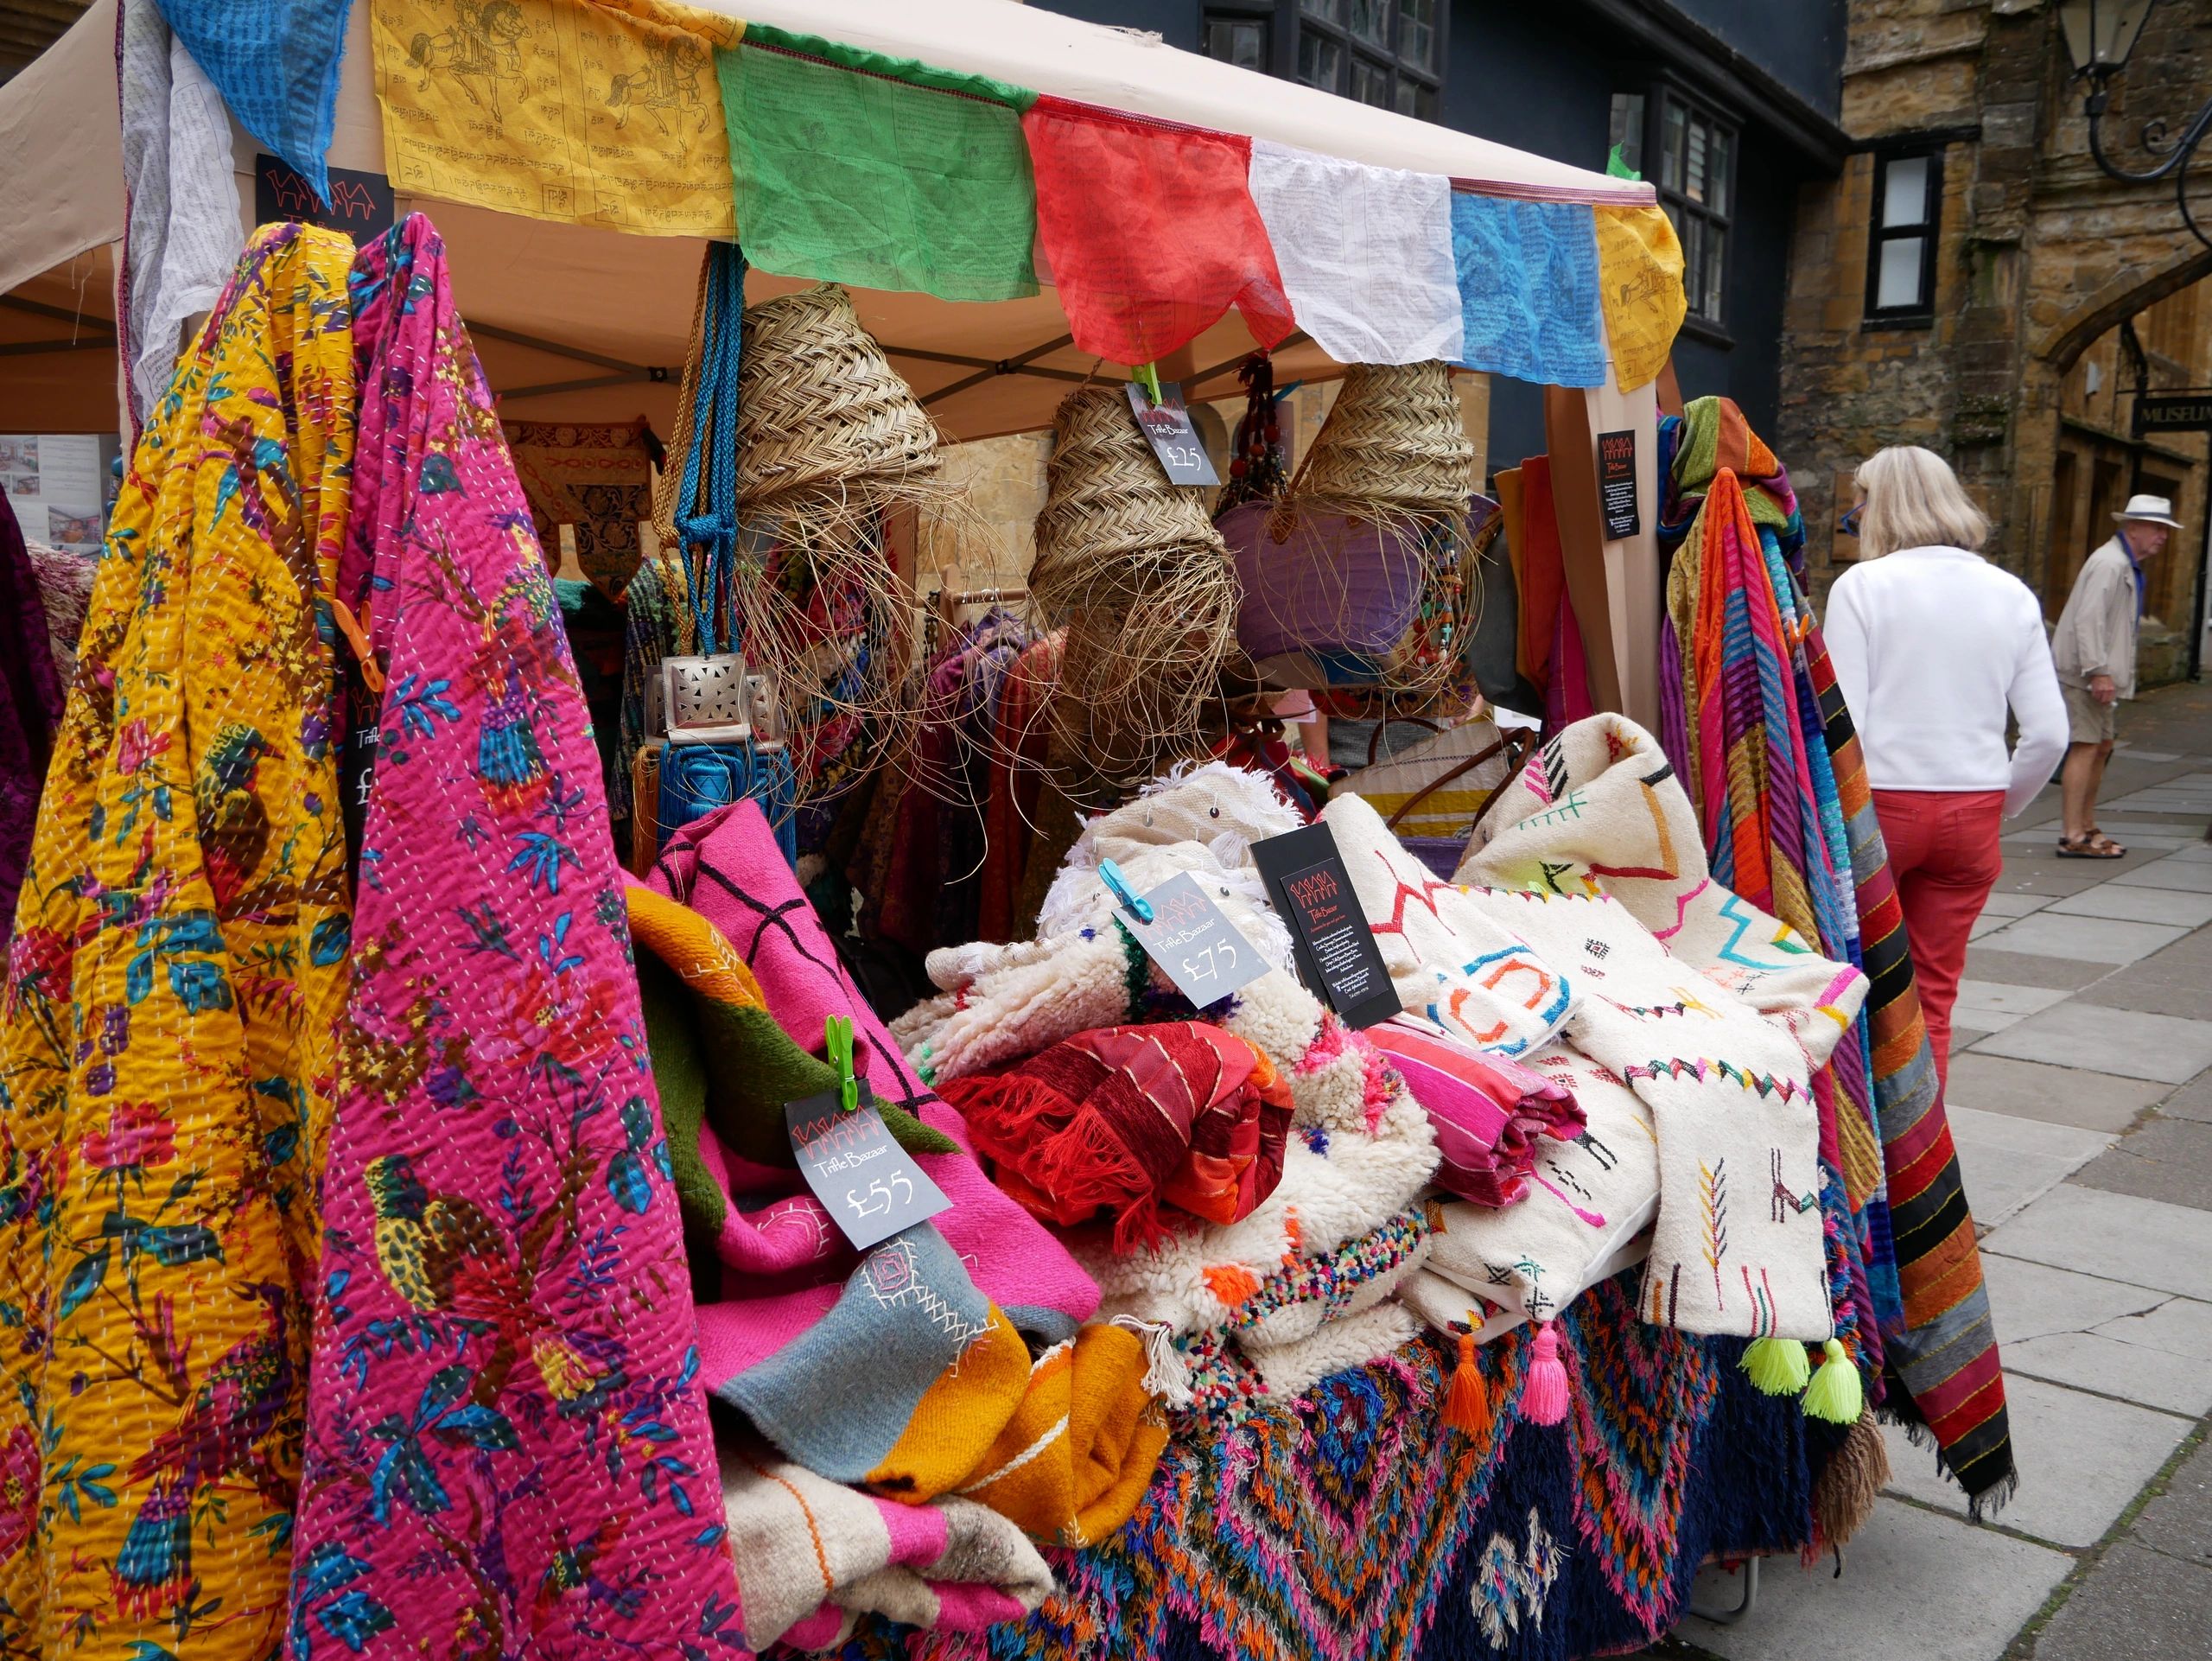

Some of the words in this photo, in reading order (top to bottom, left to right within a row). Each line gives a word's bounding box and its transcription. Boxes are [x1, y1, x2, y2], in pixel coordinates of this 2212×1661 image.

[1166, 446, 1202, 471] £25
[1153, 935, 1183, 953] Trifle
[1177, 918, 1215, 943] Bazaar
[1182, 937, 1236, 983] £75
[812, 1156, 849, 1179] Trifle
[843, 1144, 888, 1168] Bazaar
[846, 1168, 913, 1219] £55
